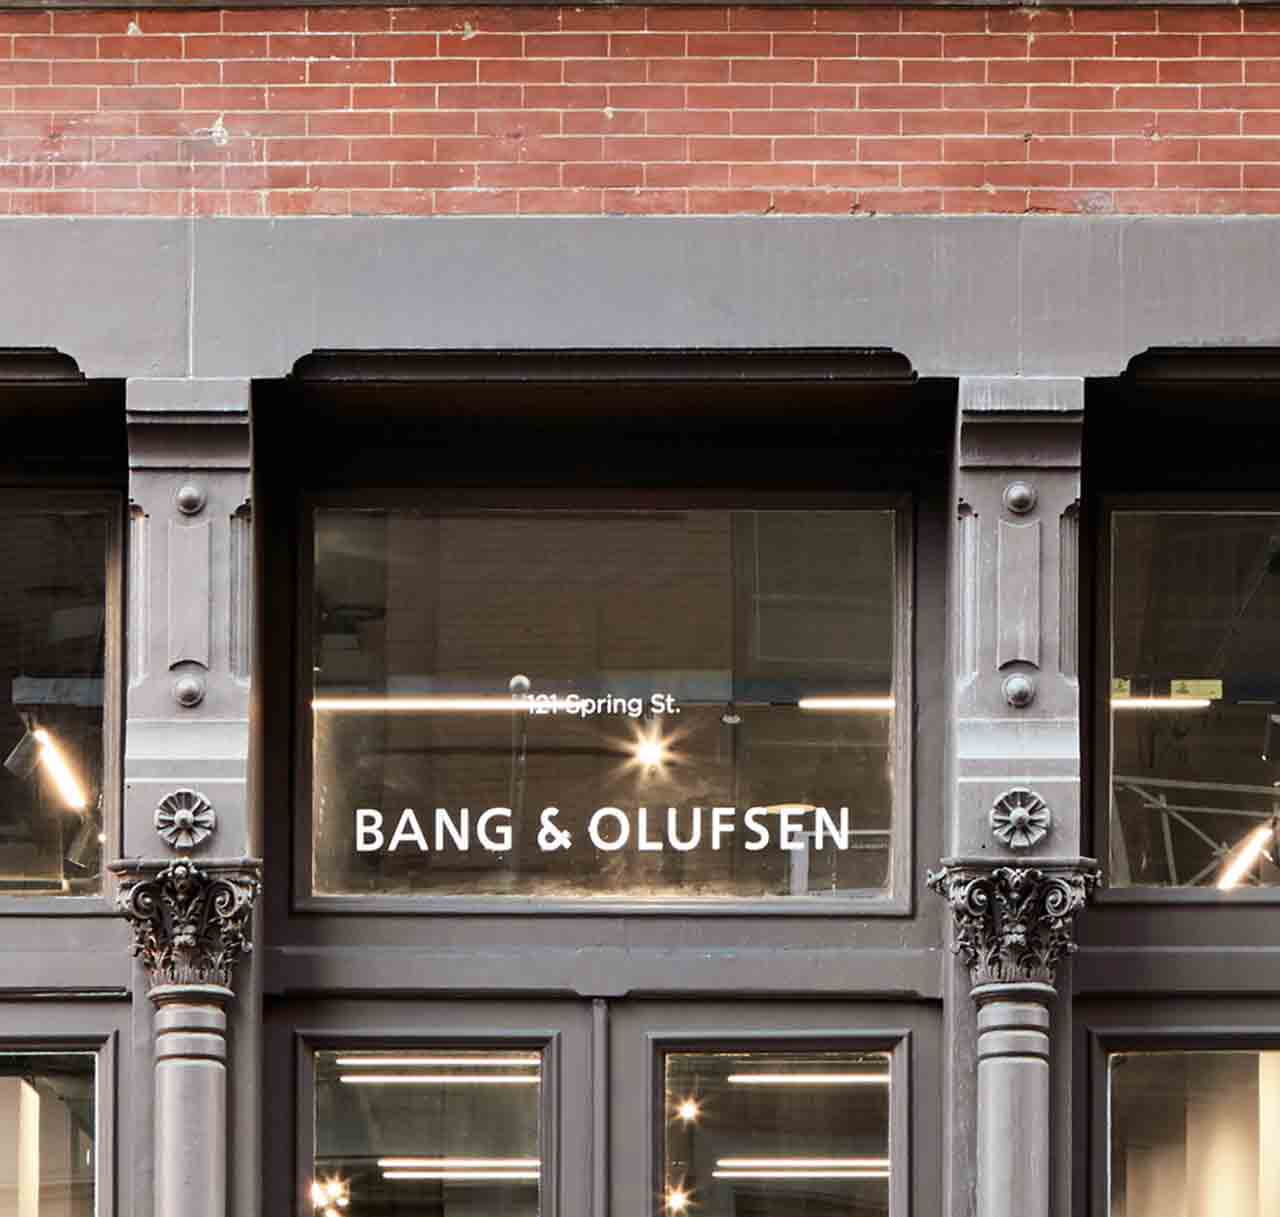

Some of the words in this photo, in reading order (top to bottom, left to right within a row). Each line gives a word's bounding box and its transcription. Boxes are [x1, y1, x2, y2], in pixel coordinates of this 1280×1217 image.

[527, 693, 558, 715] 121
[565, 693, 643, 718] Spring
[650, 693, 681, 714] St.
[354, 806, 513, 851] BANG
[536, 806, 573, 852] &
[588, 806, 850, 852] OLUFSEN
